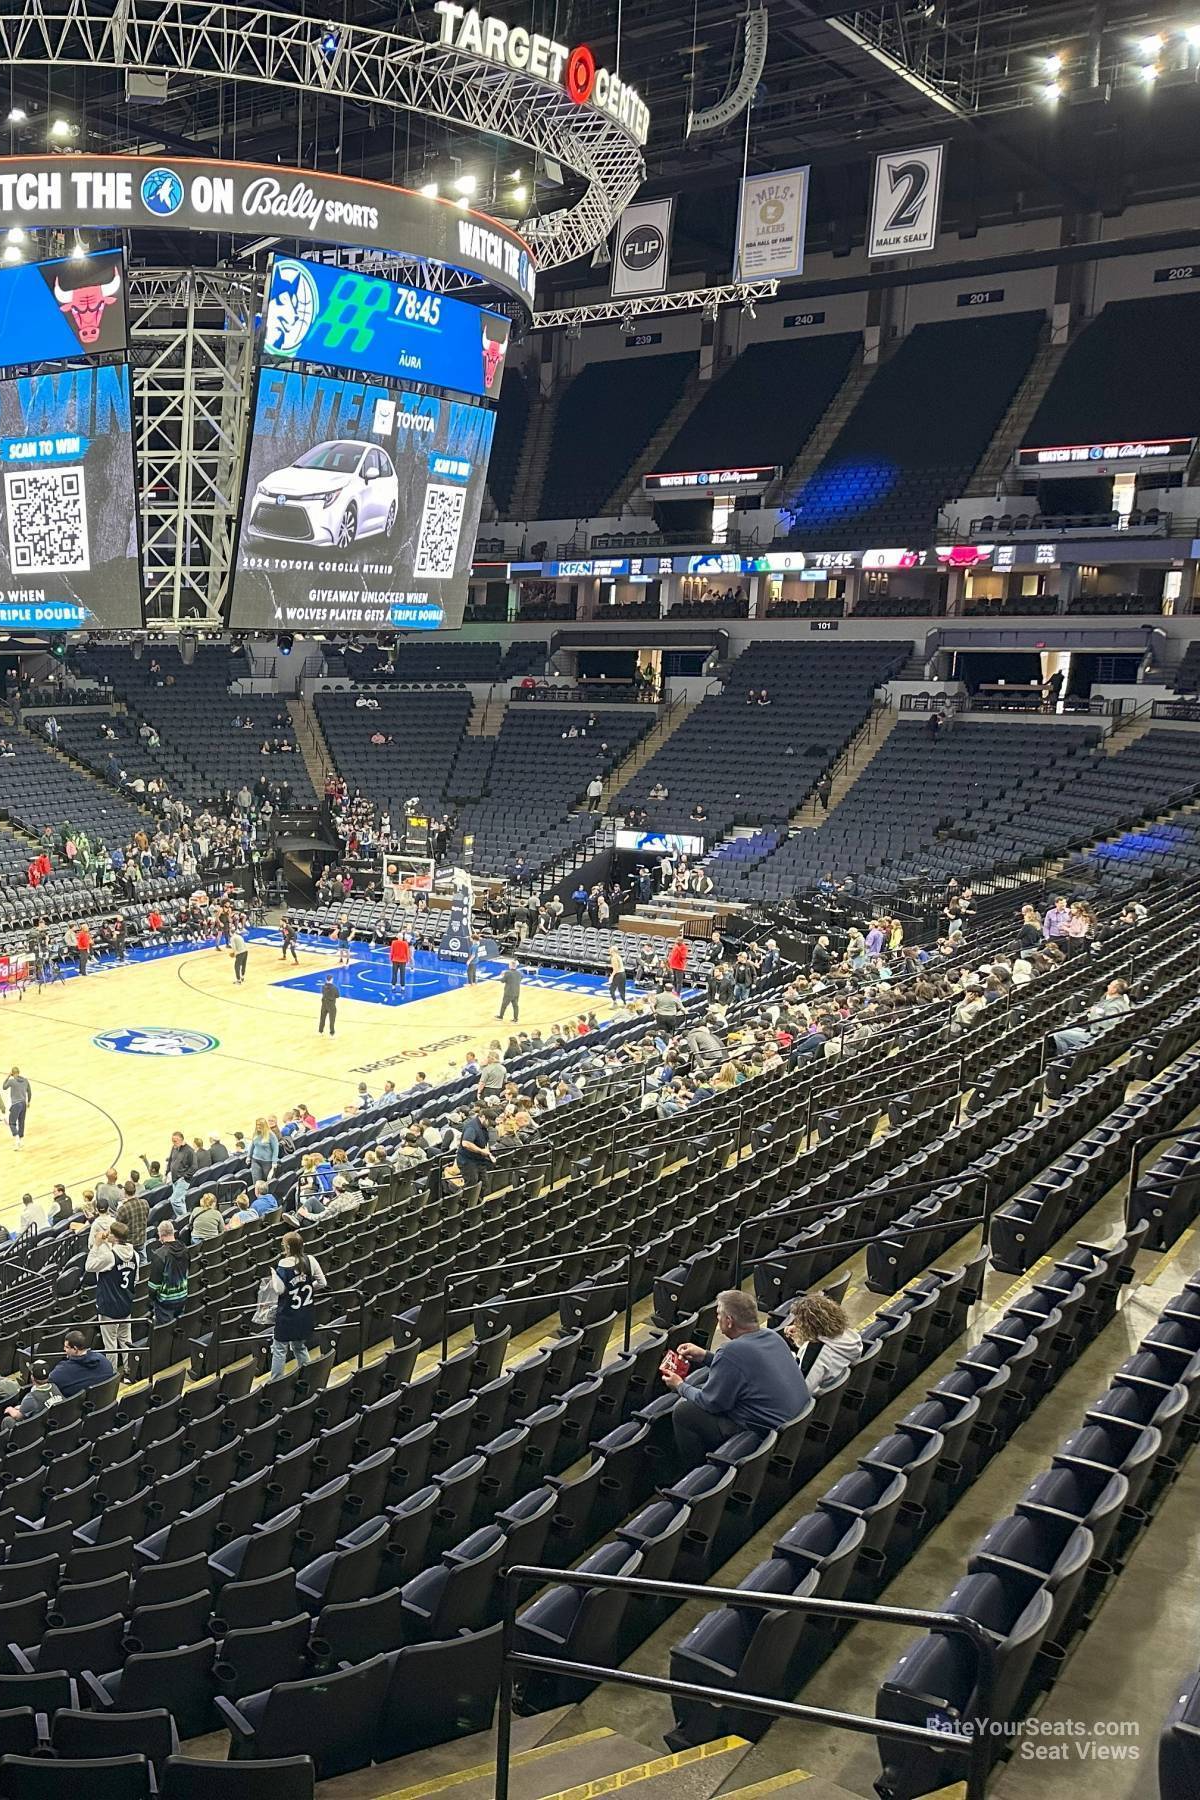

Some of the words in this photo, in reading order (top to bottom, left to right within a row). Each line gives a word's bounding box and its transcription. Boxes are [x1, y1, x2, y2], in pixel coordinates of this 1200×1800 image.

[434, 1, 569, 83] TARGET
[592, 67, 650, 141] CENTER
[71, 172, 133, 209] THE
[191, 176, 234, 215] ON
[241, 177, 326, 230] Bally
[324, 200, 378, 229] SPORTS
[884, 159, 930, 231] 2
[756, 223, 785, 236] LAKERS
[458, 220, 501, 269] WATCH
[875, 236, 901, 247] MALIK
[902, 231, 929, 245] SEALY
[624, 239, 660, 256] FLIP
[1168, 267, 1193, 280] 202
[970, 292, 990, 304] 201
[394, 287, 442, 327] 78:45
[794, 315, 814, 325] 240
[635, 335, 651, 345] 239
[18, 362, 132, 438] WIN
[396, 411, 435, 433] TOYOTA
[446, 399, 498, 464] WIN
[9, 441, 37, 460] SCAN
[39, 440, 52, 456] TO
[55, 436, 81, 455] WIN
[242, 558, 271, 569] 2024
[274, 559, 314, 571] TOYOTA
[318, 561, 360, 573] COROLLA
[362, 563, 393, 575] HYBRID
[784, 557, 791, 567] 0
[815, 553, 852, 567] 78:45
[877, 554, 884, 565] 0
[560, 563, 592, 574] KFAN
[6, 588, 45, 602] WHEN
[309, 589, 359, 603] GIVEAWAY
[361, 591, 405, 604] UNLOCKED
[406, 592, 428, 604] WHEN
[35, 606, 85, 621] DOUBLE
[274, 608, 282, 619] A
[286, 608, 327, 621] WOLVES
[329, 608, 362, 621] PLAYER
[364, 609, 384, 621] GETS
[386, 610, 392, 621] A
[392, 609, 416, 621] TRIPLE
[418, 609, 443, 621] DOUBLE
[817, 622, 832, 630] 101
[349, 1055, 410, 1075] TARGET
[418, 1034, 476, 1052] CENTER
[120, 1270, 131, 1289] 3
[288, 1284, 313, 1310] 32
